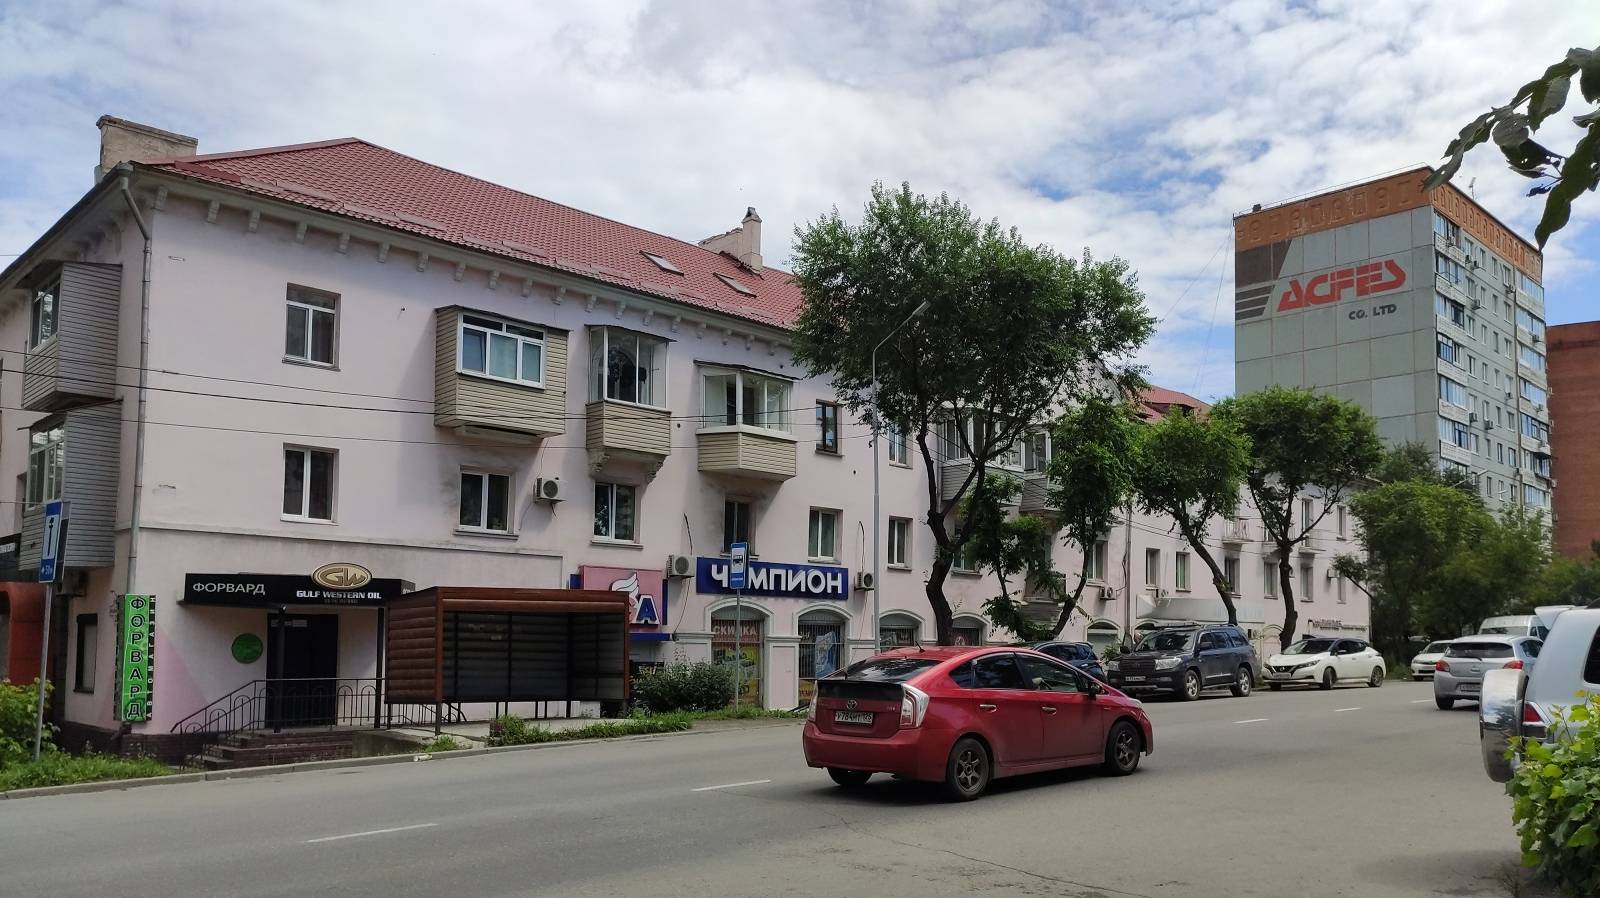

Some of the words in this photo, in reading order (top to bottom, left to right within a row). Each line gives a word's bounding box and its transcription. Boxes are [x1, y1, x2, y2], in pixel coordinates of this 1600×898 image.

[1277, 259, 1406, 312] ACFES
[1348, 309, 1368, 320] CO.
[1373, 303, 1397, 317] LTD
[319, 567, 370, 587] GW
[711, 564, 843, 594] ЧМПИОН
[192, 582, 266, 596] ФОРВАРД
[296, 590, 321, 599] GULF
[322, 591, 366, 599] WESTERN
[367, 591, 382, 599] OIL
[712, 624, 758, 637] СКИКА
[127, 596, 147, 719] ФОРВАРД
[146, 597, 156, 718] АВТОМАГАЗИН
